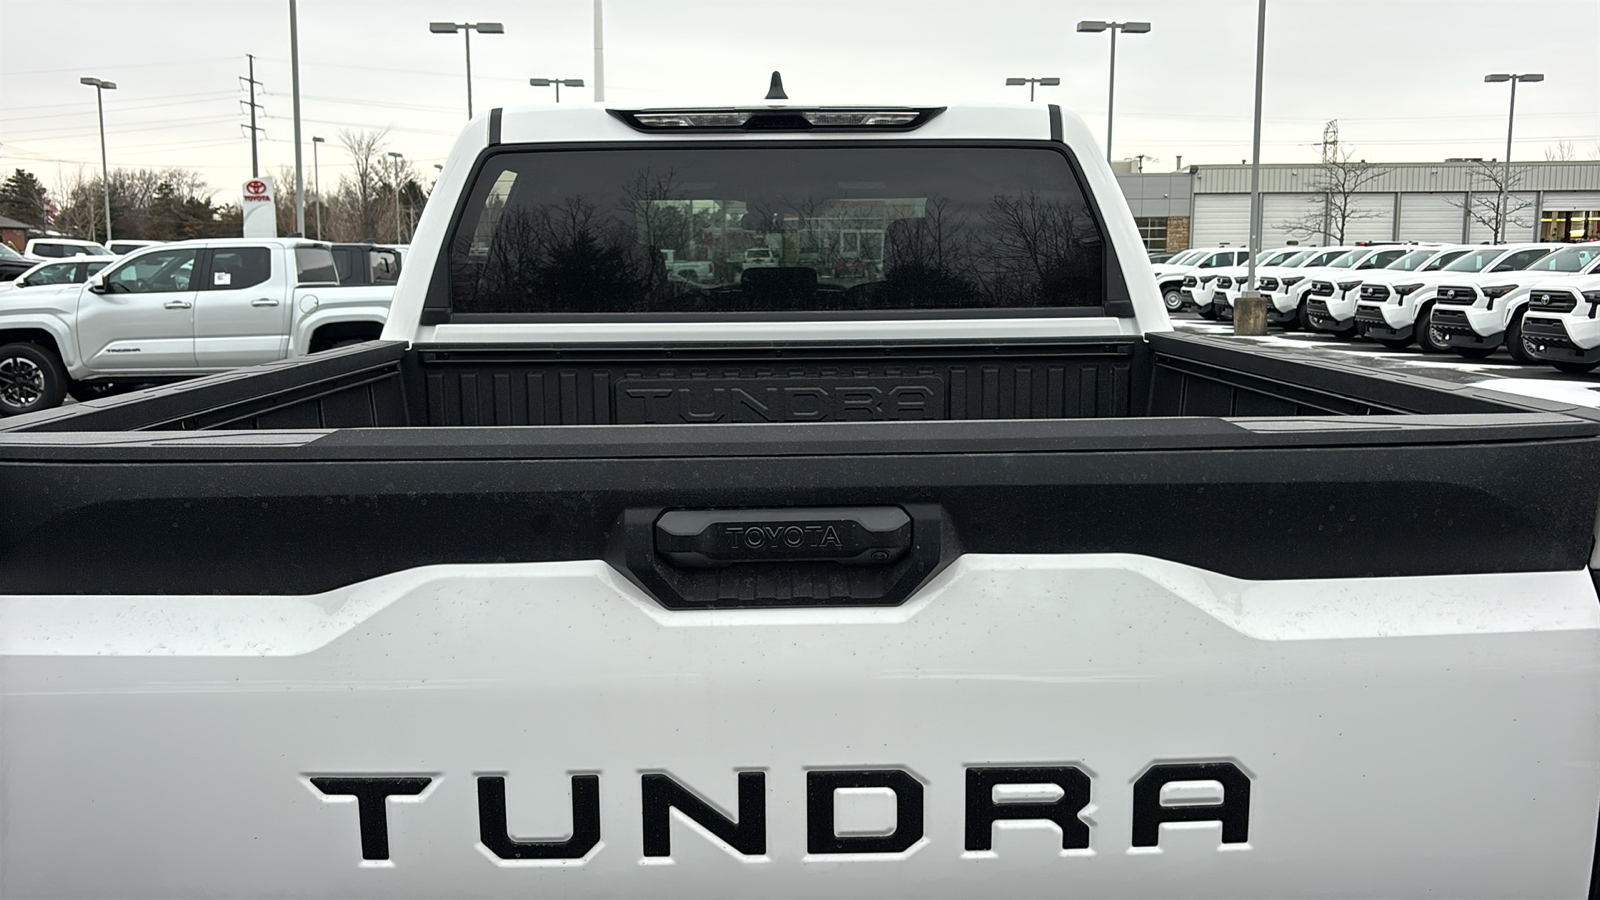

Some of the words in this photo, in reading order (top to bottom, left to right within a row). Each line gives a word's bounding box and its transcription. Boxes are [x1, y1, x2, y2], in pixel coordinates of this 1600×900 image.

[626, 386, 934, 421] TUNDRA
[726, 525, 842, 549] TOYOTA
[307, 759, 1254, 863] TUNDRA
